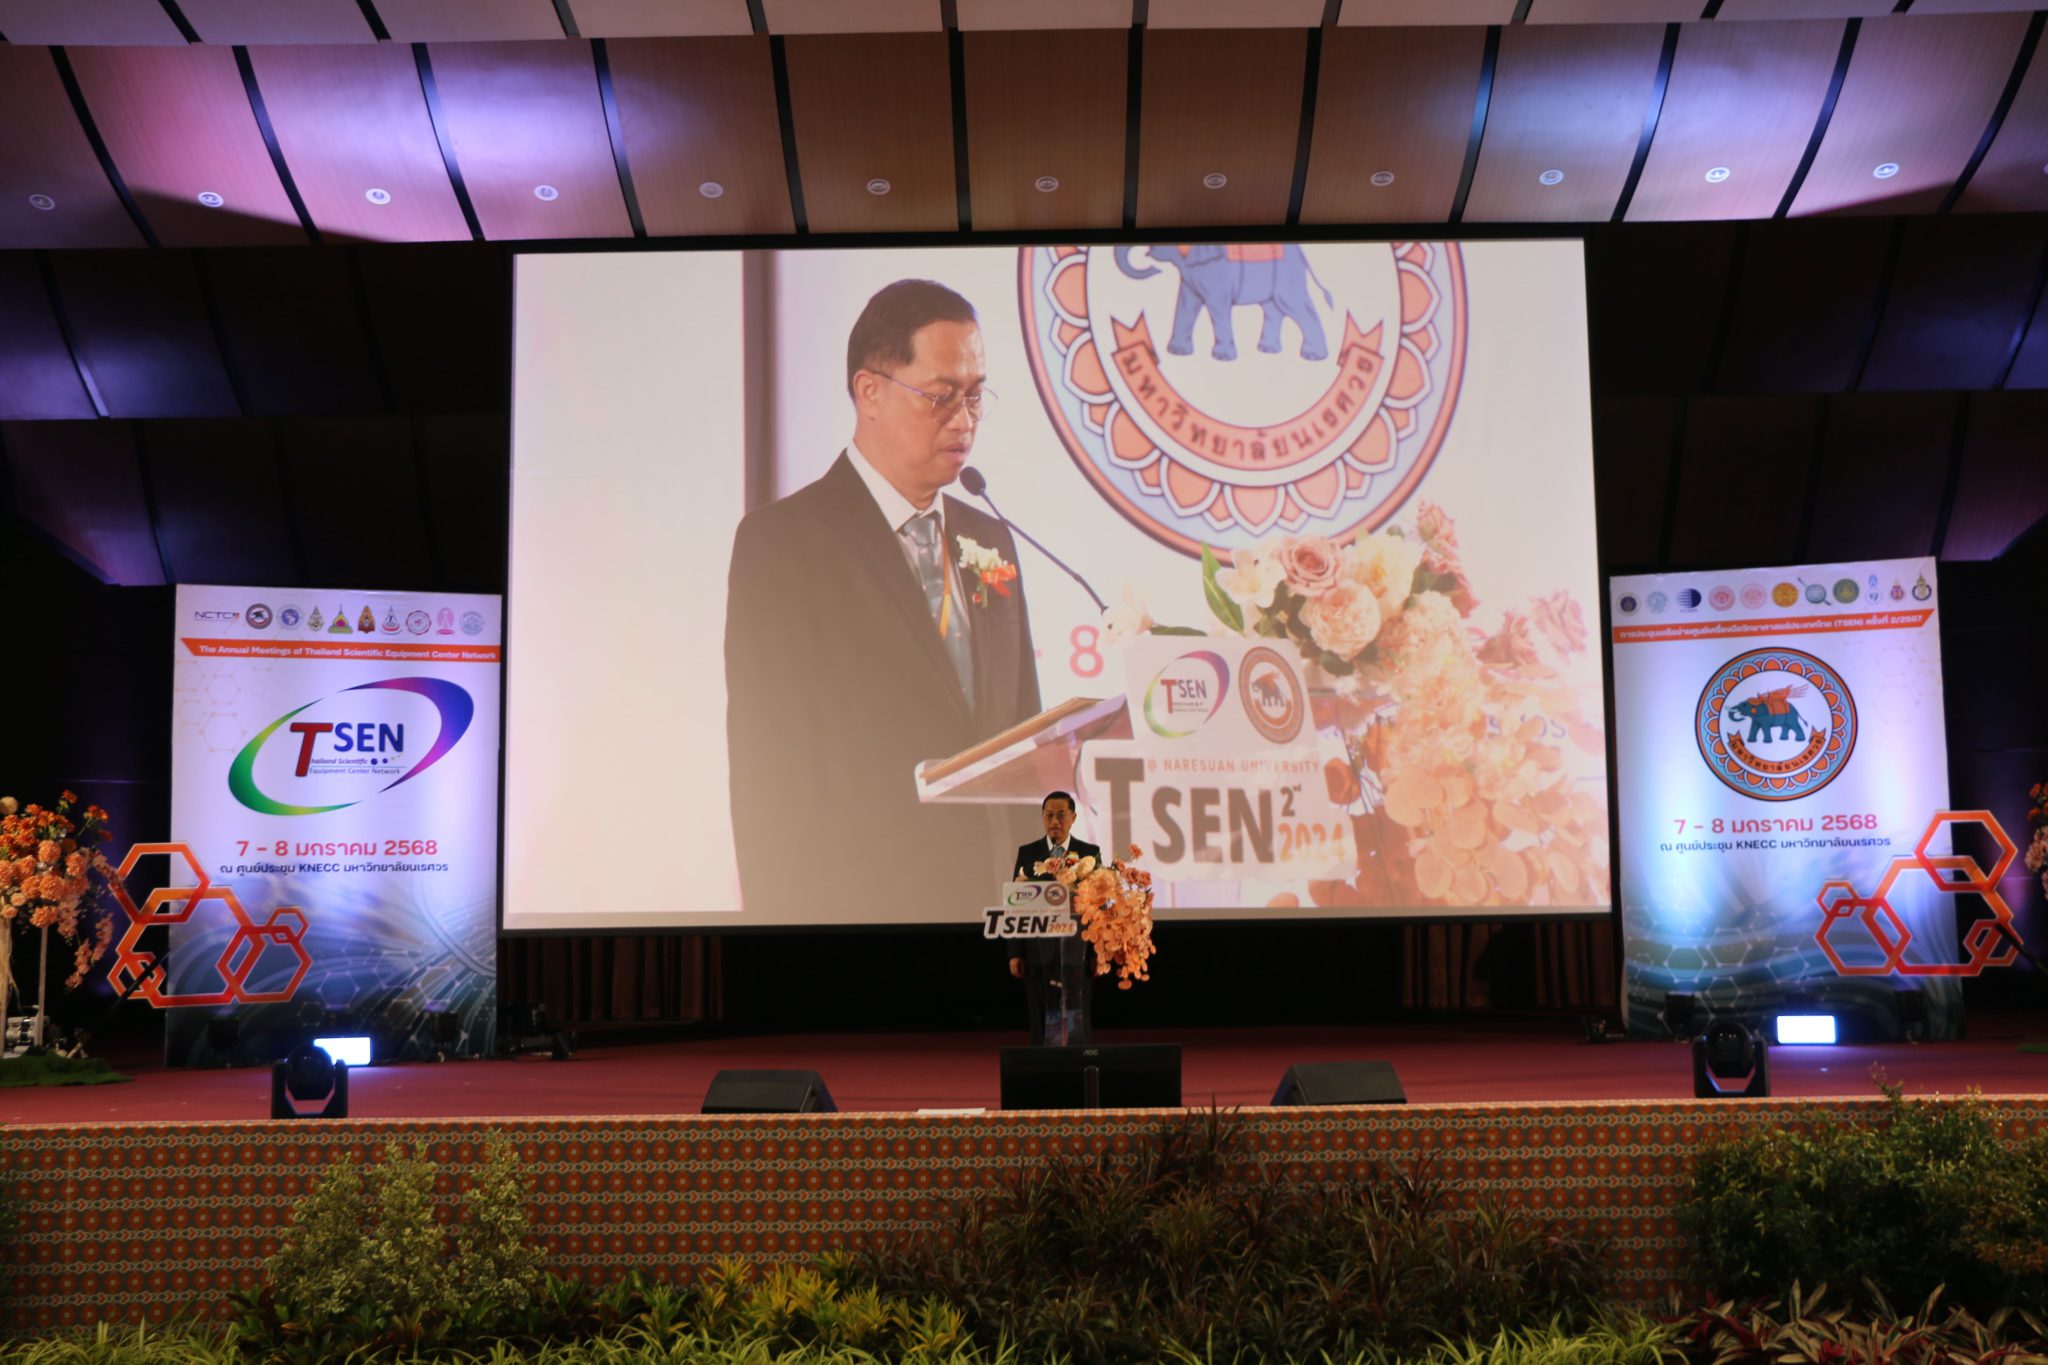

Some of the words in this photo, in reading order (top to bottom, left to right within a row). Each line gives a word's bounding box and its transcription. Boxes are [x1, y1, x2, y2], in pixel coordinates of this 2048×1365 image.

[199, 644, 216, 653] The
[218, 645, 249, 655] Annual
[251, 646, 291, 657] Meetings
[294, 647, 303, 656] of
[305, 647, 342, 657] Thailand
[344, 648, 383, 658] Scientific
[385, 650, 430, 659] Equipment
[431, 651, 460, 659] Center
[462, 652, 496, 660] Network
[1069, 625, 1104, 678] 8
[1160, 679, 1207, 714] TSEN
[290, 722, 404, 777] TSEN
[1164, 758, 1235, 772] NARESUAN
[1095, 757, 1275, 865] TSEN
[1674, 819, 1686, 834] 7
[1711, 818, 1725, 833] 8
[1731, 818, 1813, 833] มกราคม
[1821, 814, 1878, 830] 2568
[236, 841, 249, 857] 7
[275, 841, 289, 857] 8
[296, 843, 377, 857] มกราคม
[384, 840, 438, 856] 2568
[1660, 843, 1672, 851] ณ
[1676, 840, 1733, 853] ศูนย์ประชุม
[1736, 840, 1777, 849] KNECC
[1781, 837, 1891, 848] มหาวิทยาลัยนเรศวร
[220, 865, 232, 873] ณ
[237, 863, 295, 876] ศูนย์ประชุม
[299, 863, 340, 872] KNECC
[344, 862, 449, 873] มหาวิทยาลัยนเรศวร
[986, 910, 1049, 934] TSEN
